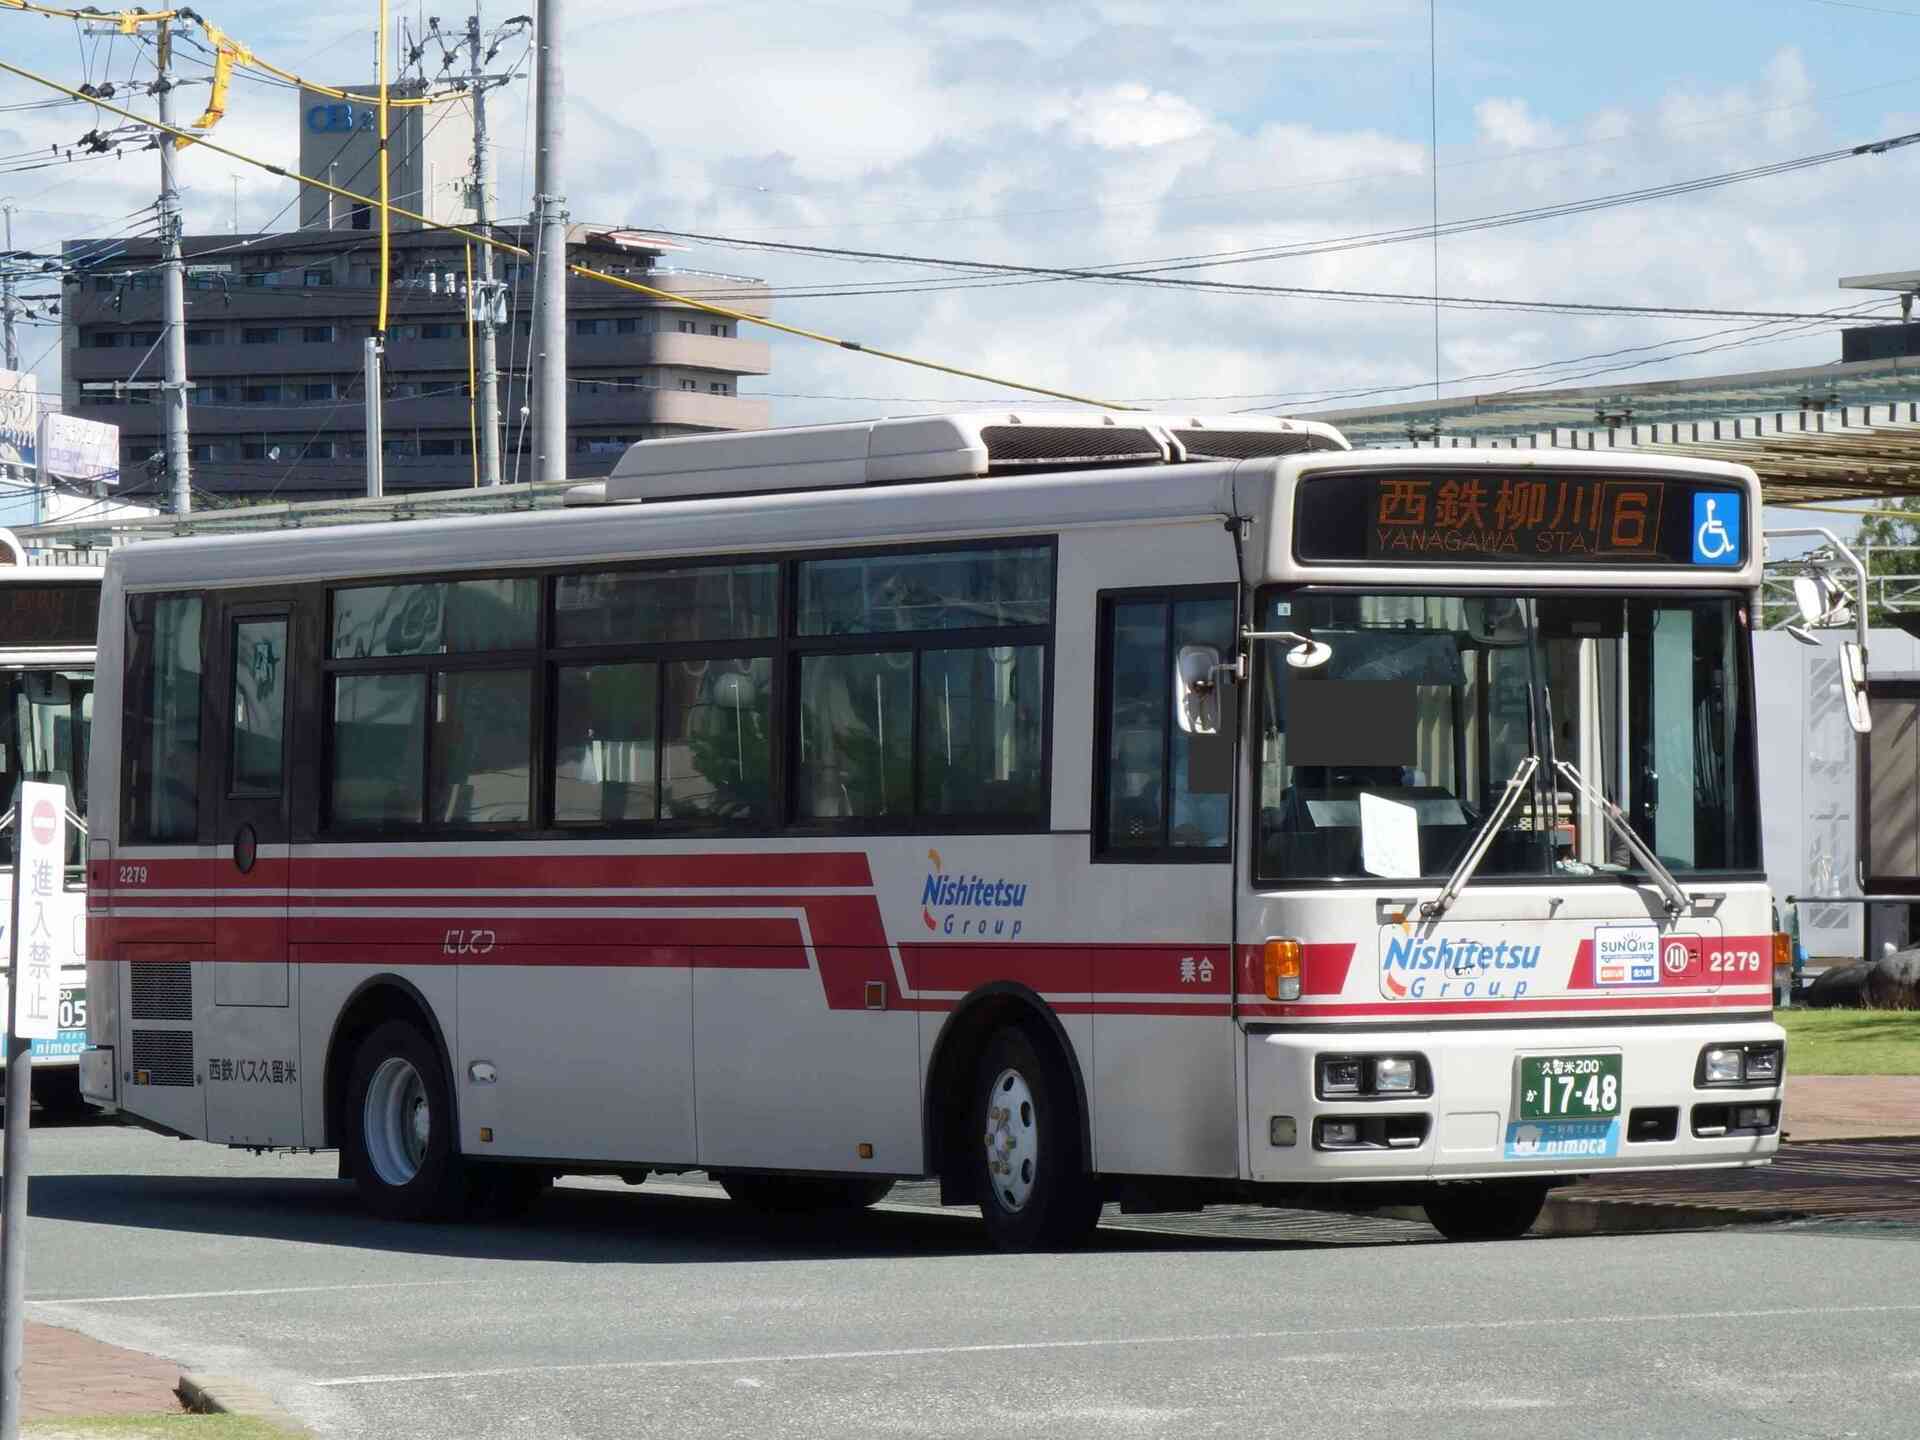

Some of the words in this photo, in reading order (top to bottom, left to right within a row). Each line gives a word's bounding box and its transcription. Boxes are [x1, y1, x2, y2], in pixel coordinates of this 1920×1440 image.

[1378, 480, 1600, 528] 西鉄柳川
[1611, 492, 1648, 546] 6
[1377, 529, 1519, 552] YANAGAWA
[119, 866, 148, 883] 2279
[922, 873, 1026, 907] Nishitetsu
[28, 858, 53, 1019] 進入禁止
[944, 914, 1022, 939] Group
[1383, 936, 1541, 971] Nishitetsu
[1710, 952, 1760, 971] 2279
[1180, 956, 1215, 983] 乗合
[1410, 977, 1528, 999] Group
[208, 1058, 297, 1085] 西鉄バス久留米
[1541, 1059, 1600, 1075] 久留米200
[1543, 1075, 1617, 1114] 17-48
[1546, 1139, 1607, 1155] nimoca
